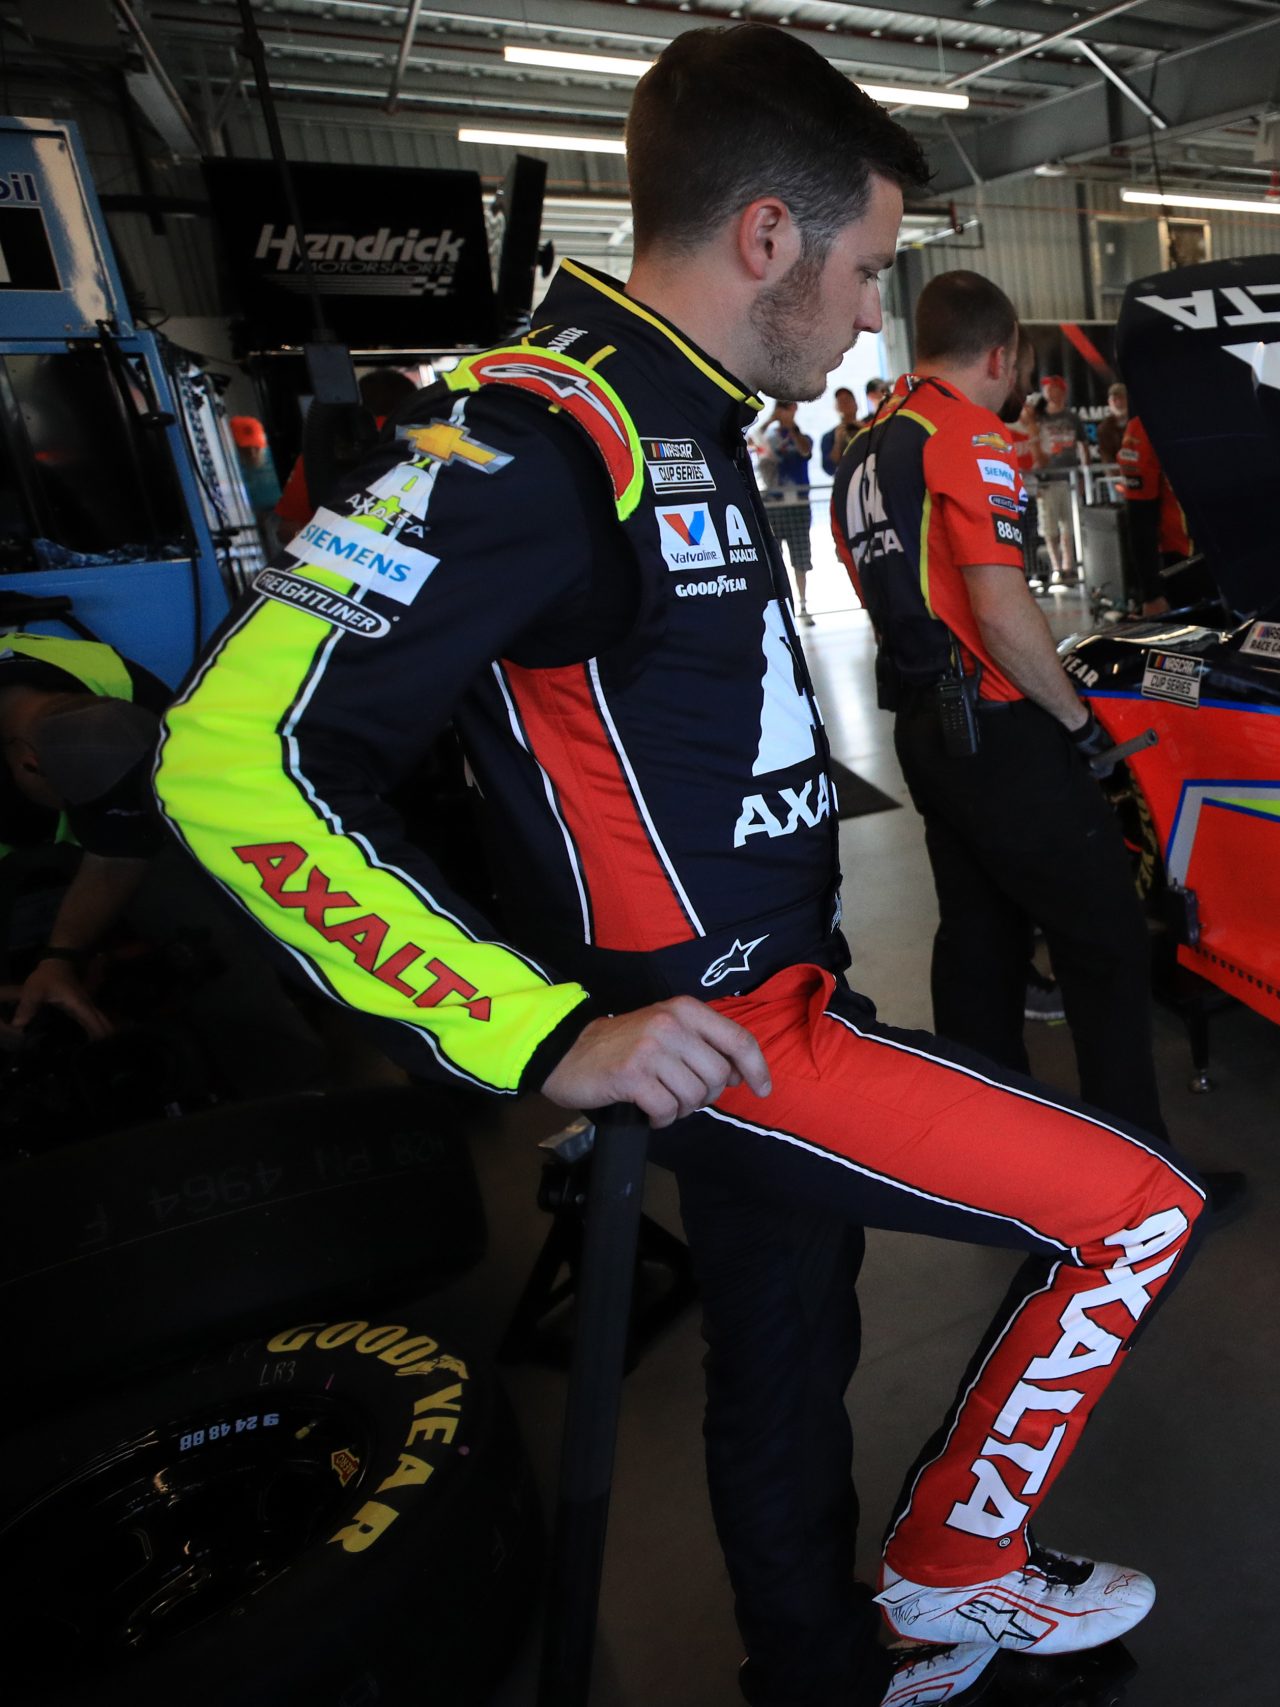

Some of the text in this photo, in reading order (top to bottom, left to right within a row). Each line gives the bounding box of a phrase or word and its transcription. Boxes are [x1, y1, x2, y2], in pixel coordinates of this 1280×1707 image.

[663, 443, 693, 459] NASCAR
[658, 466, 704, 481] CUP SERIES
[345, 493, 425, 539] AXALTA
[997, 520, 1013, 540] 88
[301, 524, 412, 582] SIEMENS
[670, 549, 717, 564] Valvoline
[729, 547, 759, 564] AXALTA
[675, 574, 748, 598] GOODYEAR
[259, 573, 378, 632] FREIGHTLINER
[1250, 639, 1271, 652] RACE
[1163, 657, 1195, 675] NASCAR
[1150, 676, 1192, 695] CUP SERIES
[945, 1207, 1189, 1539] AXALTA
[179, 1412, 281, 1452] 9 24 48 88
[266, 1320, 471, 1553] GOODYEAR
